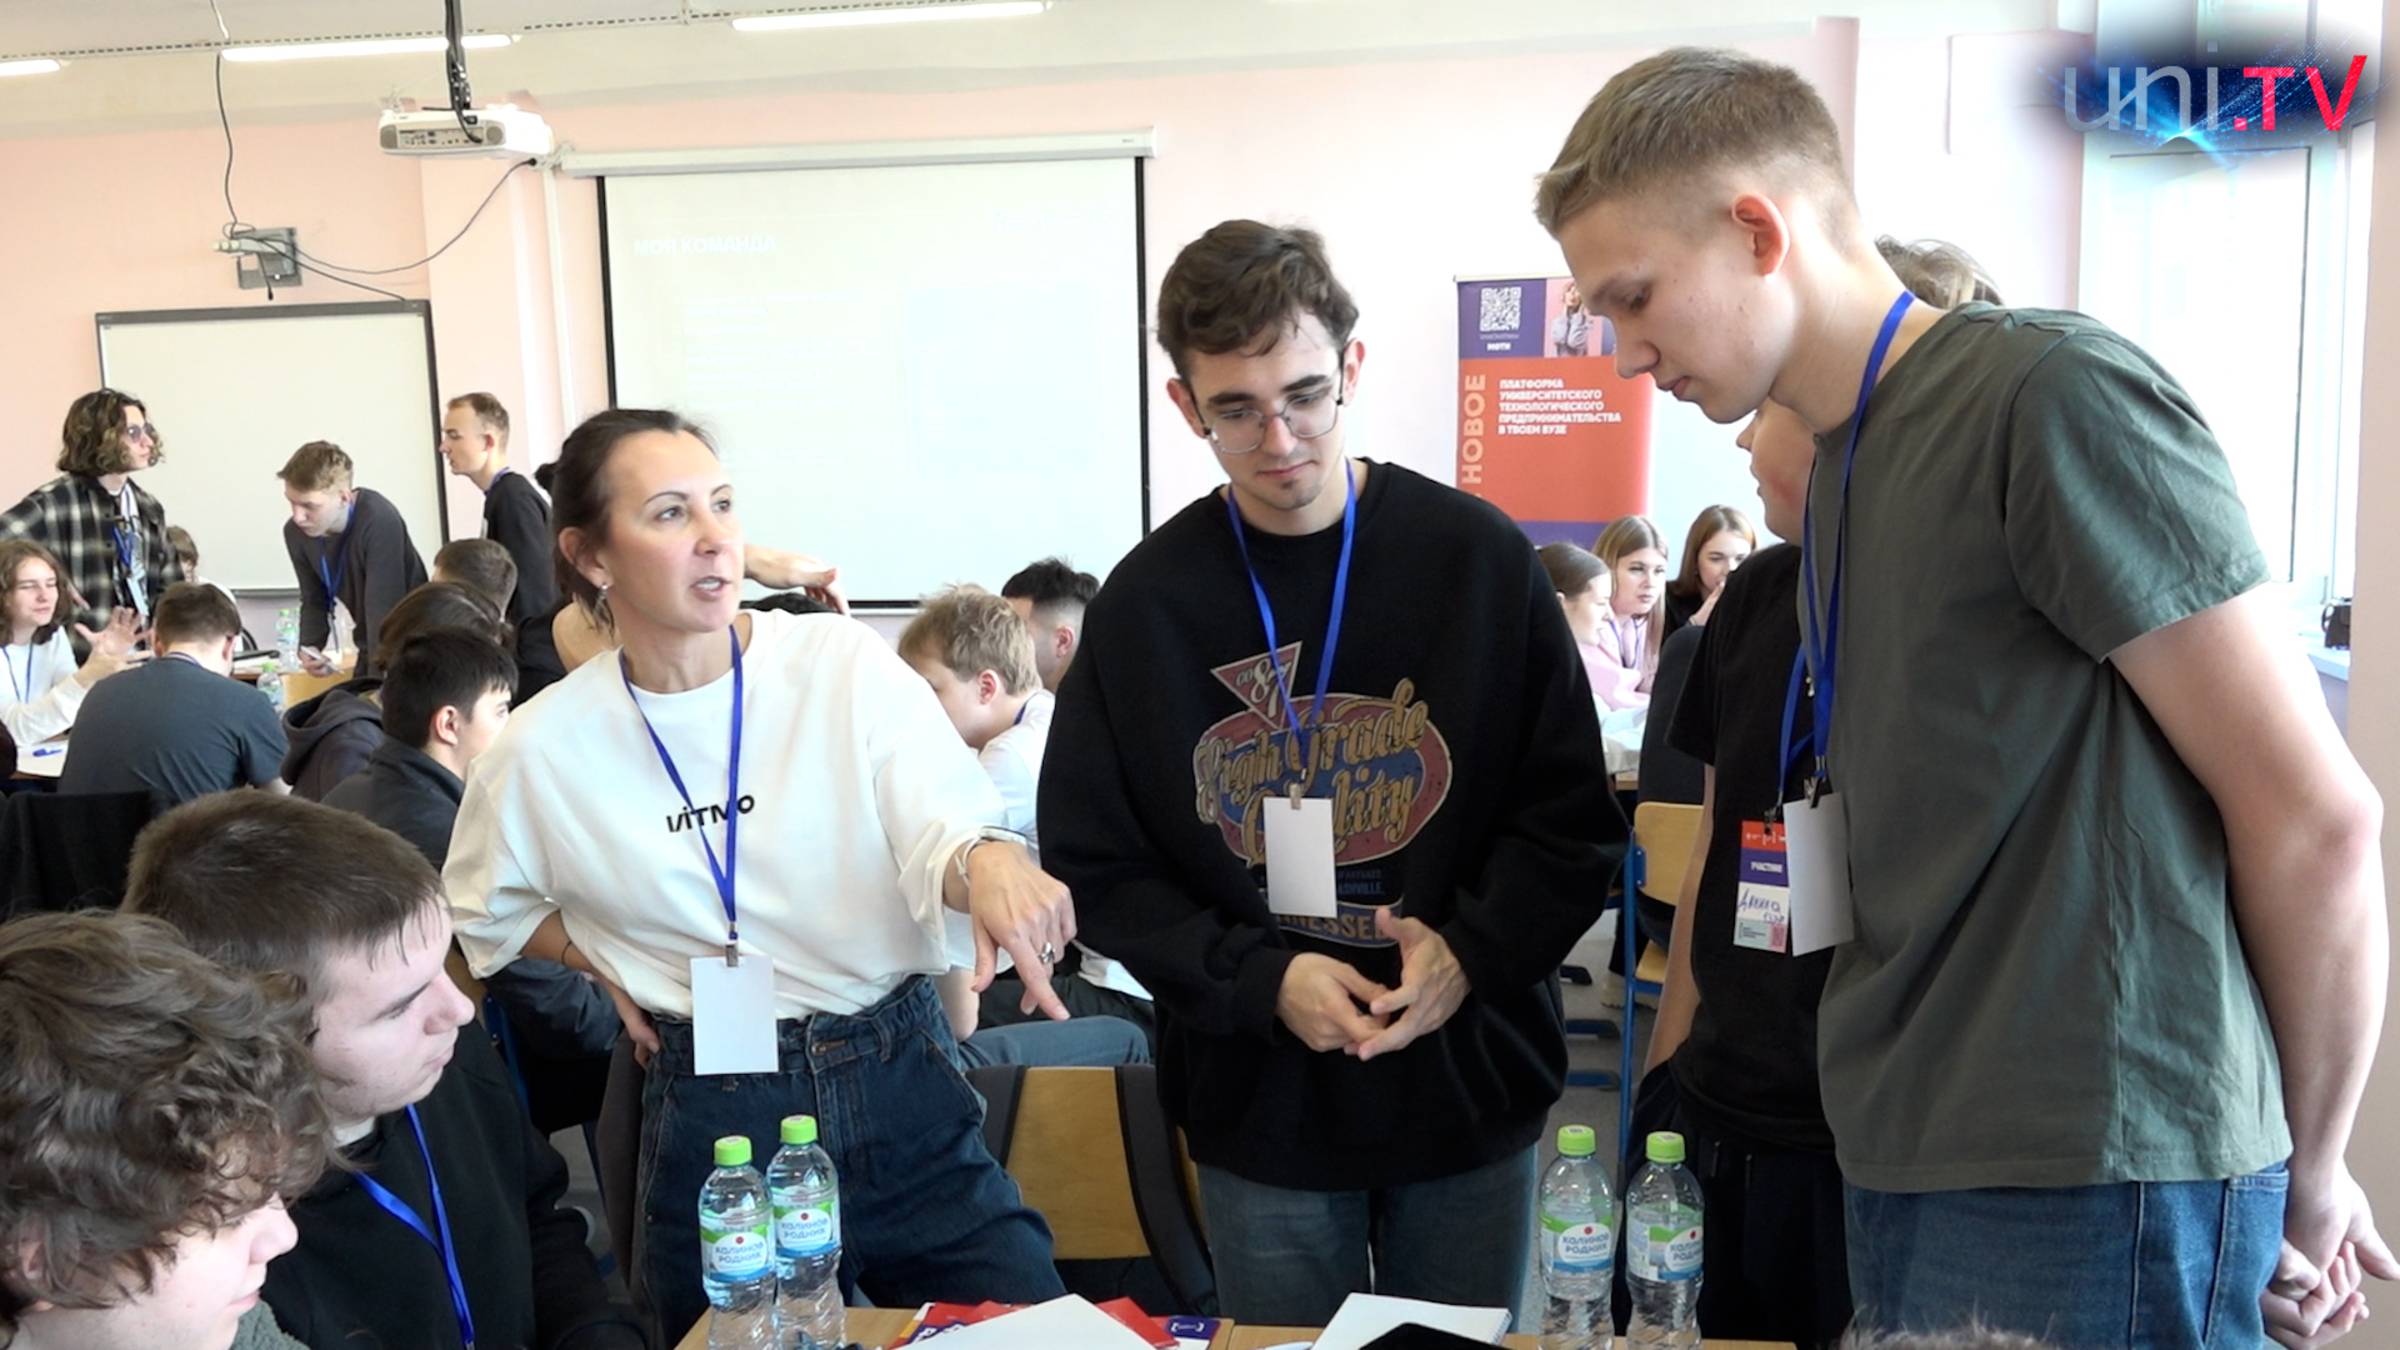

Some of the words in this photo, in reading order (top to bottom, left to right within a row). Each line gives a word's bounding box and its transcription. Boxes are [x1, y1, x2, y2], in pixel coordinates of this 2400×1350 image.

[1499, 379, 1564, 389] ПЛАТФОРМА
[1499, 390, 1602, 400] УНИВЕРСИТЕТСКОГО
[1499, 401, 1604, 412] ТЕХНОЛОГИЧЕСКОГО
[1498, 413, 1621, 423] ПРЕДПРИНИМАТЕЛЬСТВА
[1462, 374, 1486, 484] НОВОЕ
[1498, 425, 1506, 434] В
[1507, 425, 1540, 434] ТВОЕМ
[1543, 425, 1567, 434] ВУЗЕ
